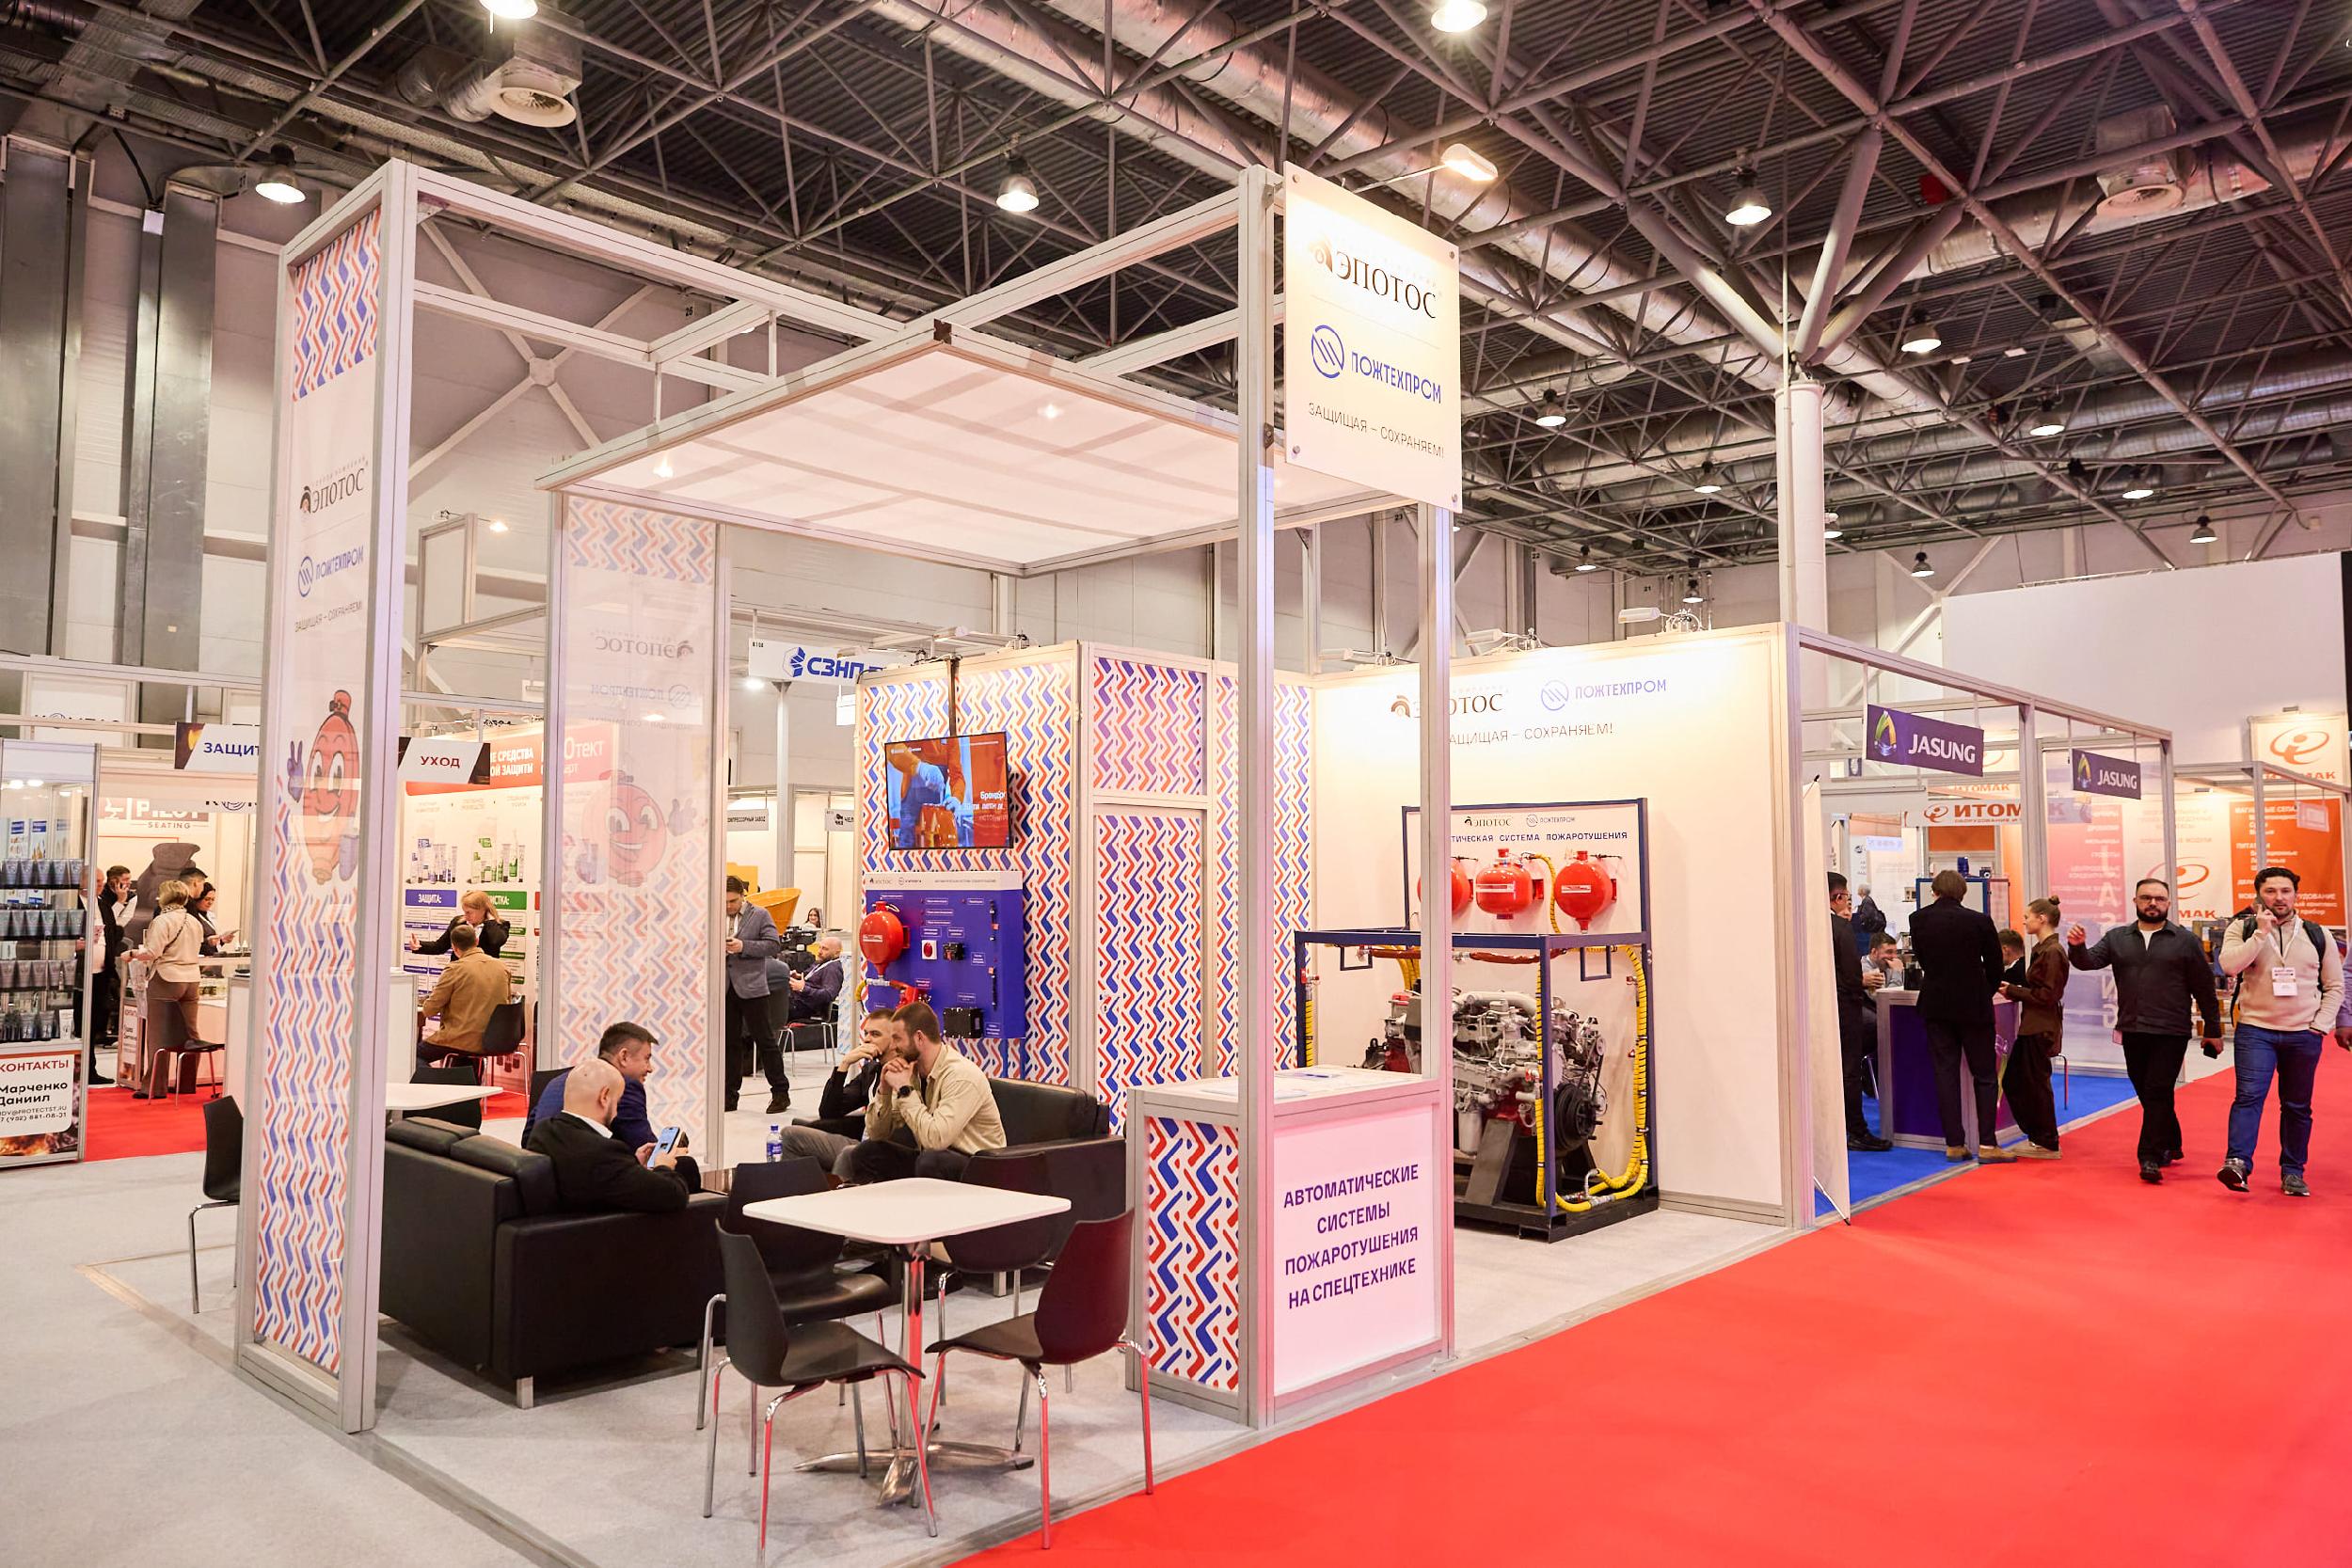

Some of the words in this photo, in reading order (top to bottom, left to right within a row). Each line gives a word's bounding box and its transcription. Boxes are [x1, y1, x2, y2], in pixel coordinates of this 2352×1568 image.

[1337, 251, 1436, 318] ЭПОТОС
[685, 307, 693, 317] 26
[1351, 352, 1441, 404] ПОЖТЕХПРОМ
[1309, 403, 1367, 433] ЗАЩИЩАЯ
[1381, 426, 1444, 459] СОХРАНЯЕМ!
[311, 468, 365, 514] ЭПОТОС
[807, 657, 882, 679] СЗНП
[1575, 679, 1666, 699] ПОЖТЕХПРОМ
[1450, 731, 1508, 745] АЩИЩАЯ
[1524, 722, 1613, 739] СОХРАНЯЕМ!
[203, 742, 260, 757] ЗАЩИТ
[498, 748, 534, 762] СРЕДСТВА
[1908, 734, 1976, 764] JASUNG
[421, 755, 460, 768] УХОД
[2097, 768, 2137, 789] JASUNG
[148, 821, 191, 830] SEATING
[1451, 834, 1494, 843] ТИЧЕСКАЯ
[1499, 833, 1540, 842] СИСТЕМА
[1546, 832, 1628, 841] ПОЖАРОТУШЕНИЯ
[489, 895, 509, 905] ИСТКА:
[2178, 910, 2217, 919] МАК
[0, 1083, 68, 1095] Марченко
[1283, 1164, 1419, 1209] АВТОМАТИЧЕСКИЕ
[1316, 1202, 1391, 1235] СИСТЕМЫ
[1284, 1227, 1419, 1275] ПОЖАРОТУШЕНИЯ
[1289, 1289, 1311, 1309] НА
[1312, 1259, 1416, 1302] СПЕЦТЕХНИКЕ
